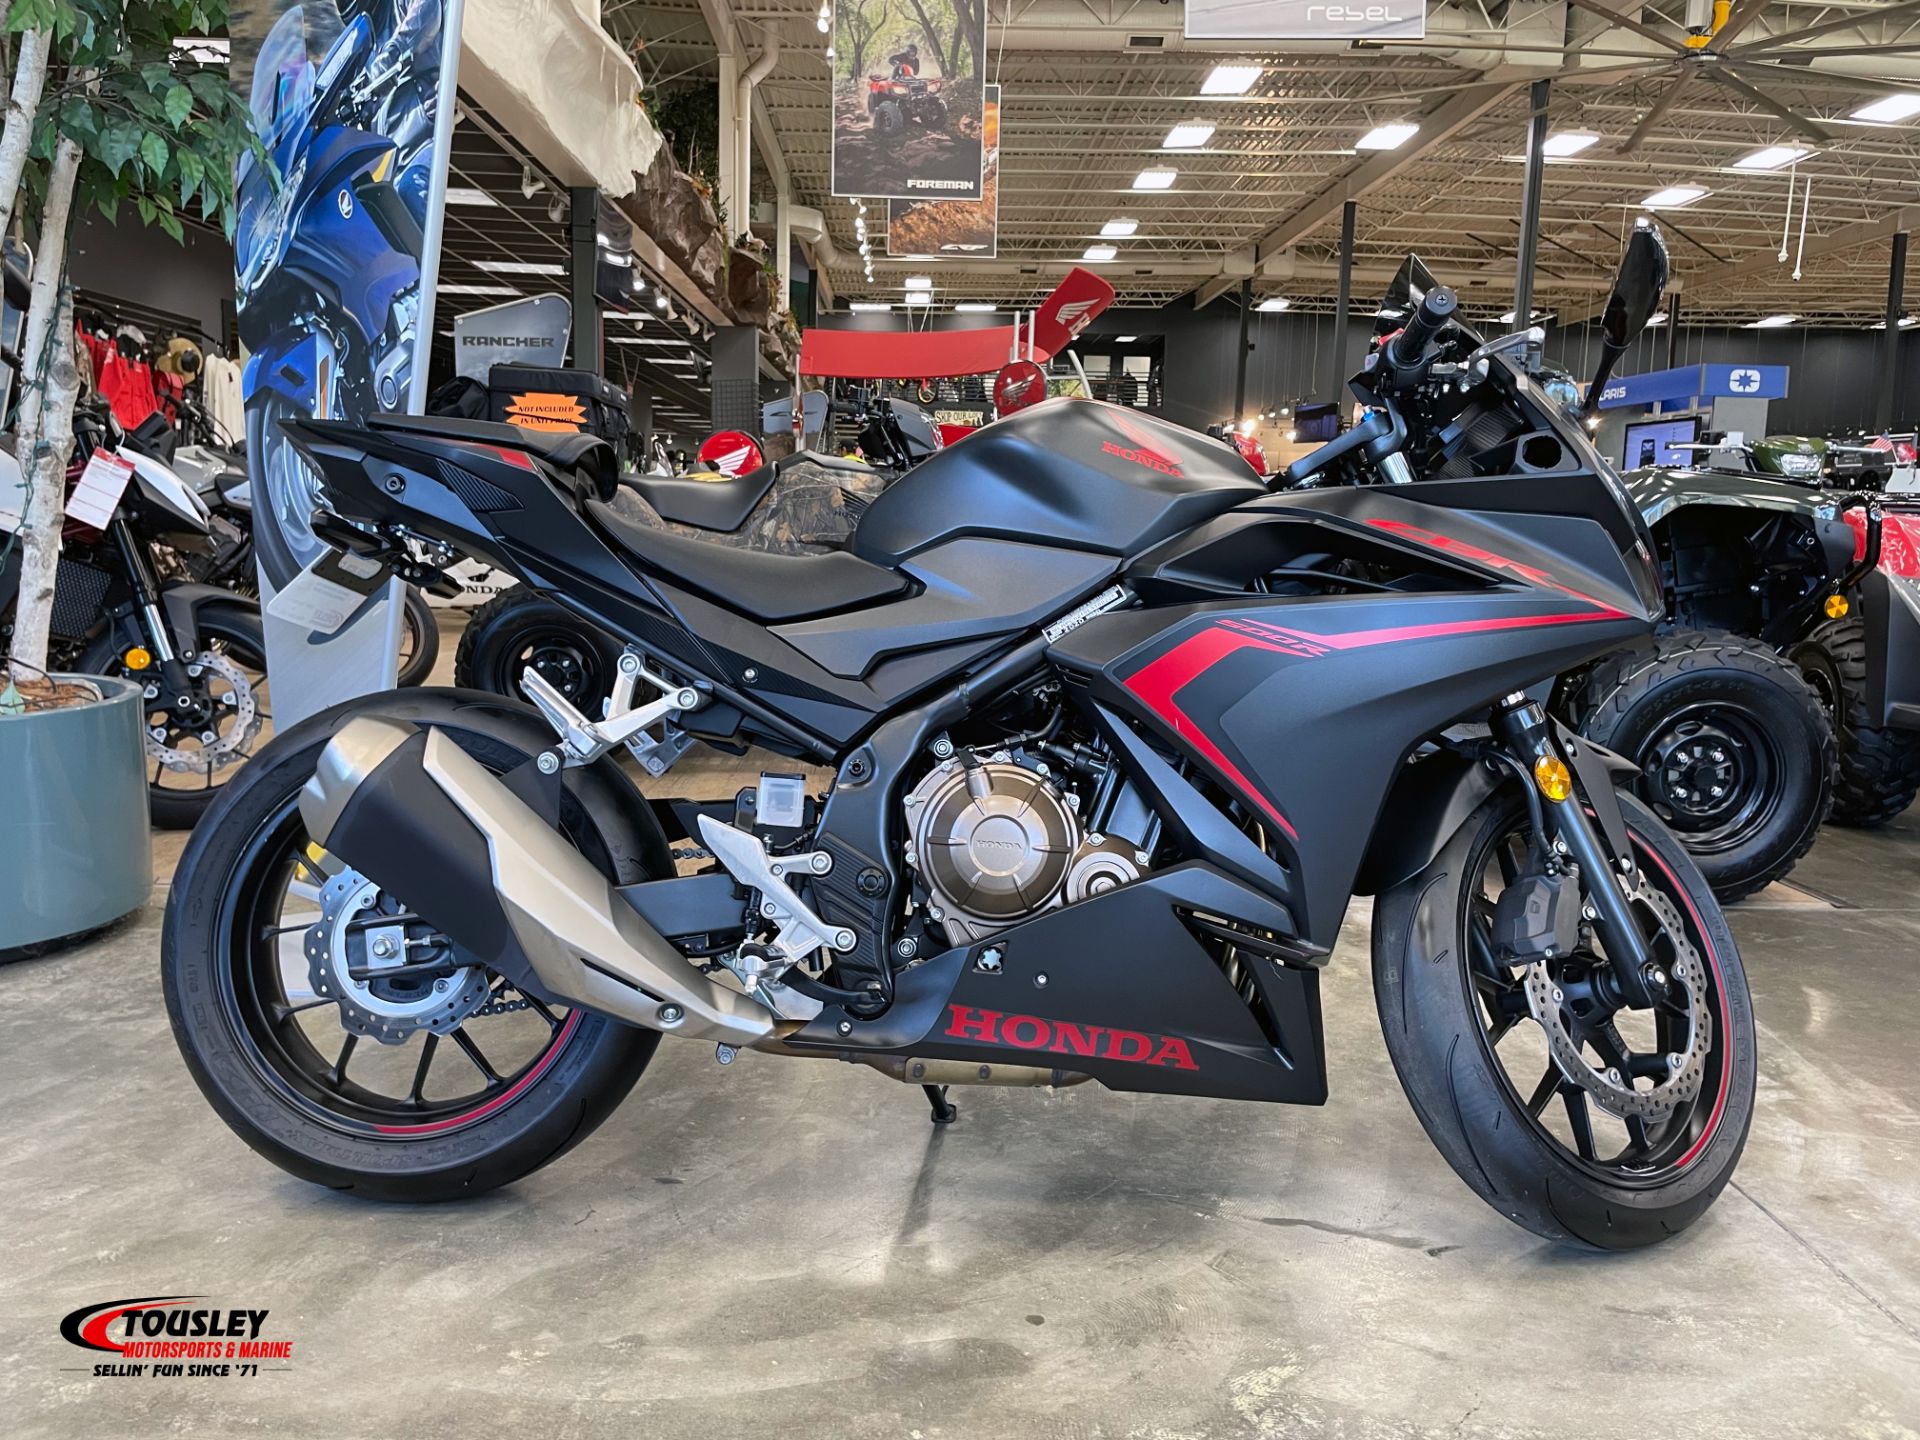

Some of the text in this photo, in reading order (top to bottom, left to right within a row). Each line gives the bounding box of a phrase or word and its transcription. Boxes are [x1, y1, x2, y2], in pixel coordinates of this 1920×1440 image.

[906, 179, 975, 191] FOREMAN
[462, 335, 555, 348] RANCHER
[518, 405, 575, 413] NOT INCLUDED
[1101, 440, 1185, 480] HONDA
[1215, 618, 1331, 657] 500R
[975, 839, 1022, 850] HONDA
[944, 1002, 1200, 1071] HONDA
